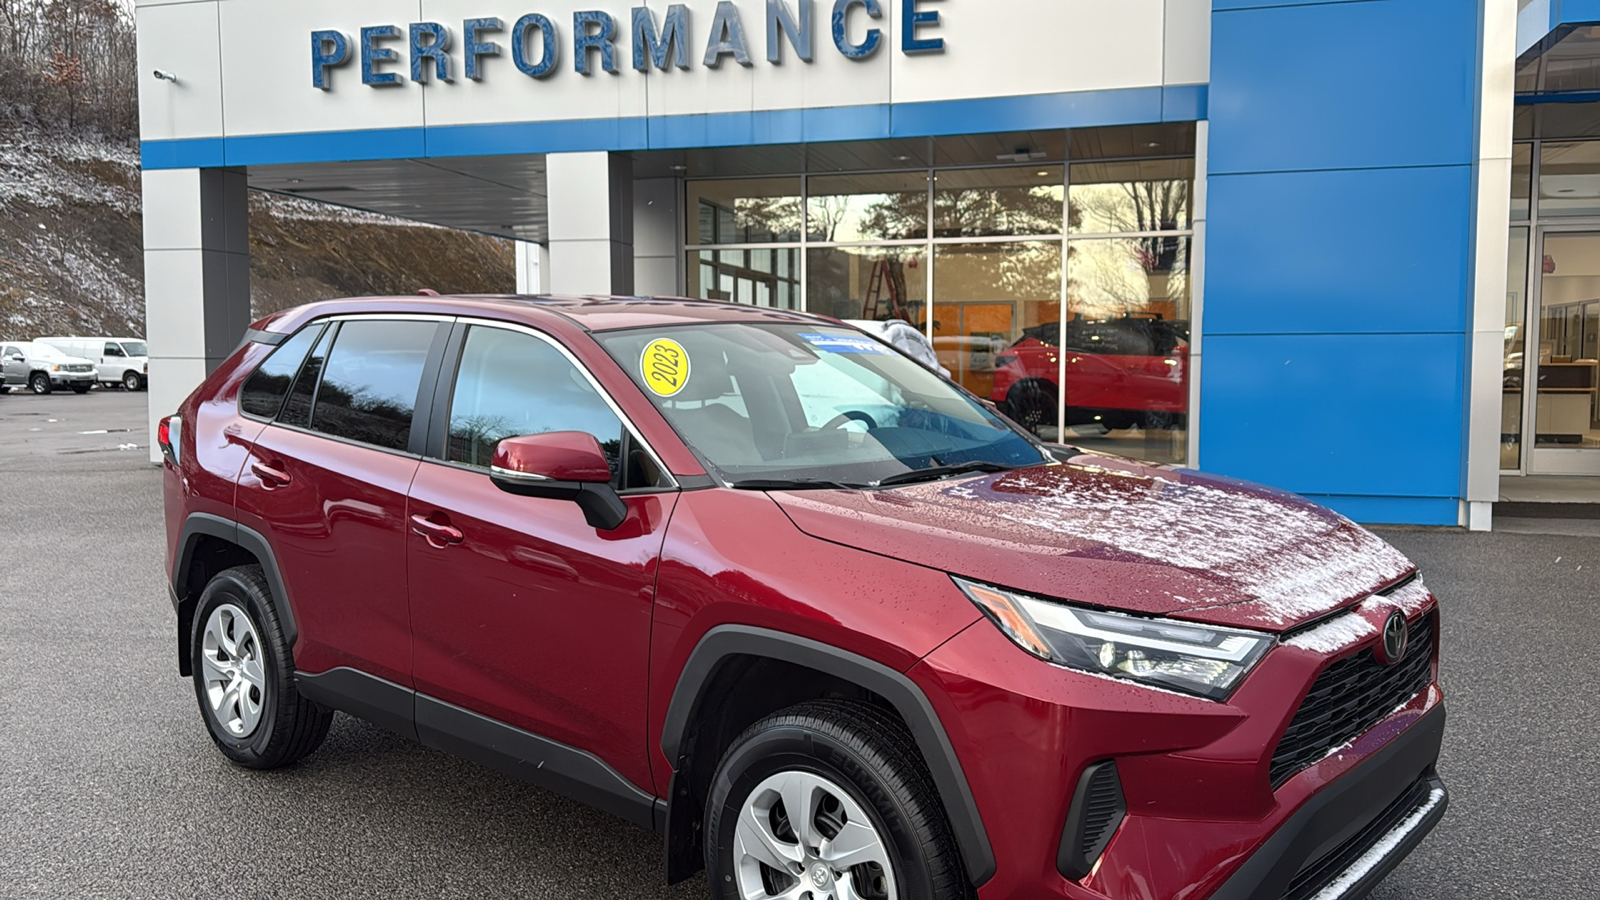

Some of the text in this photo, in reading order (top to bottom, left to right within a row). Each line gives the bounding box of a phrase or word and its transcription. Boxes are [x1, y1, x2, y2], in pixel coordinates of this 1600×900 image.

[310, 0, 946, 90] PERFORMANCE
[651, 344, 679, 388] 2023
[829, 748, 907, 834] SUMMIT
